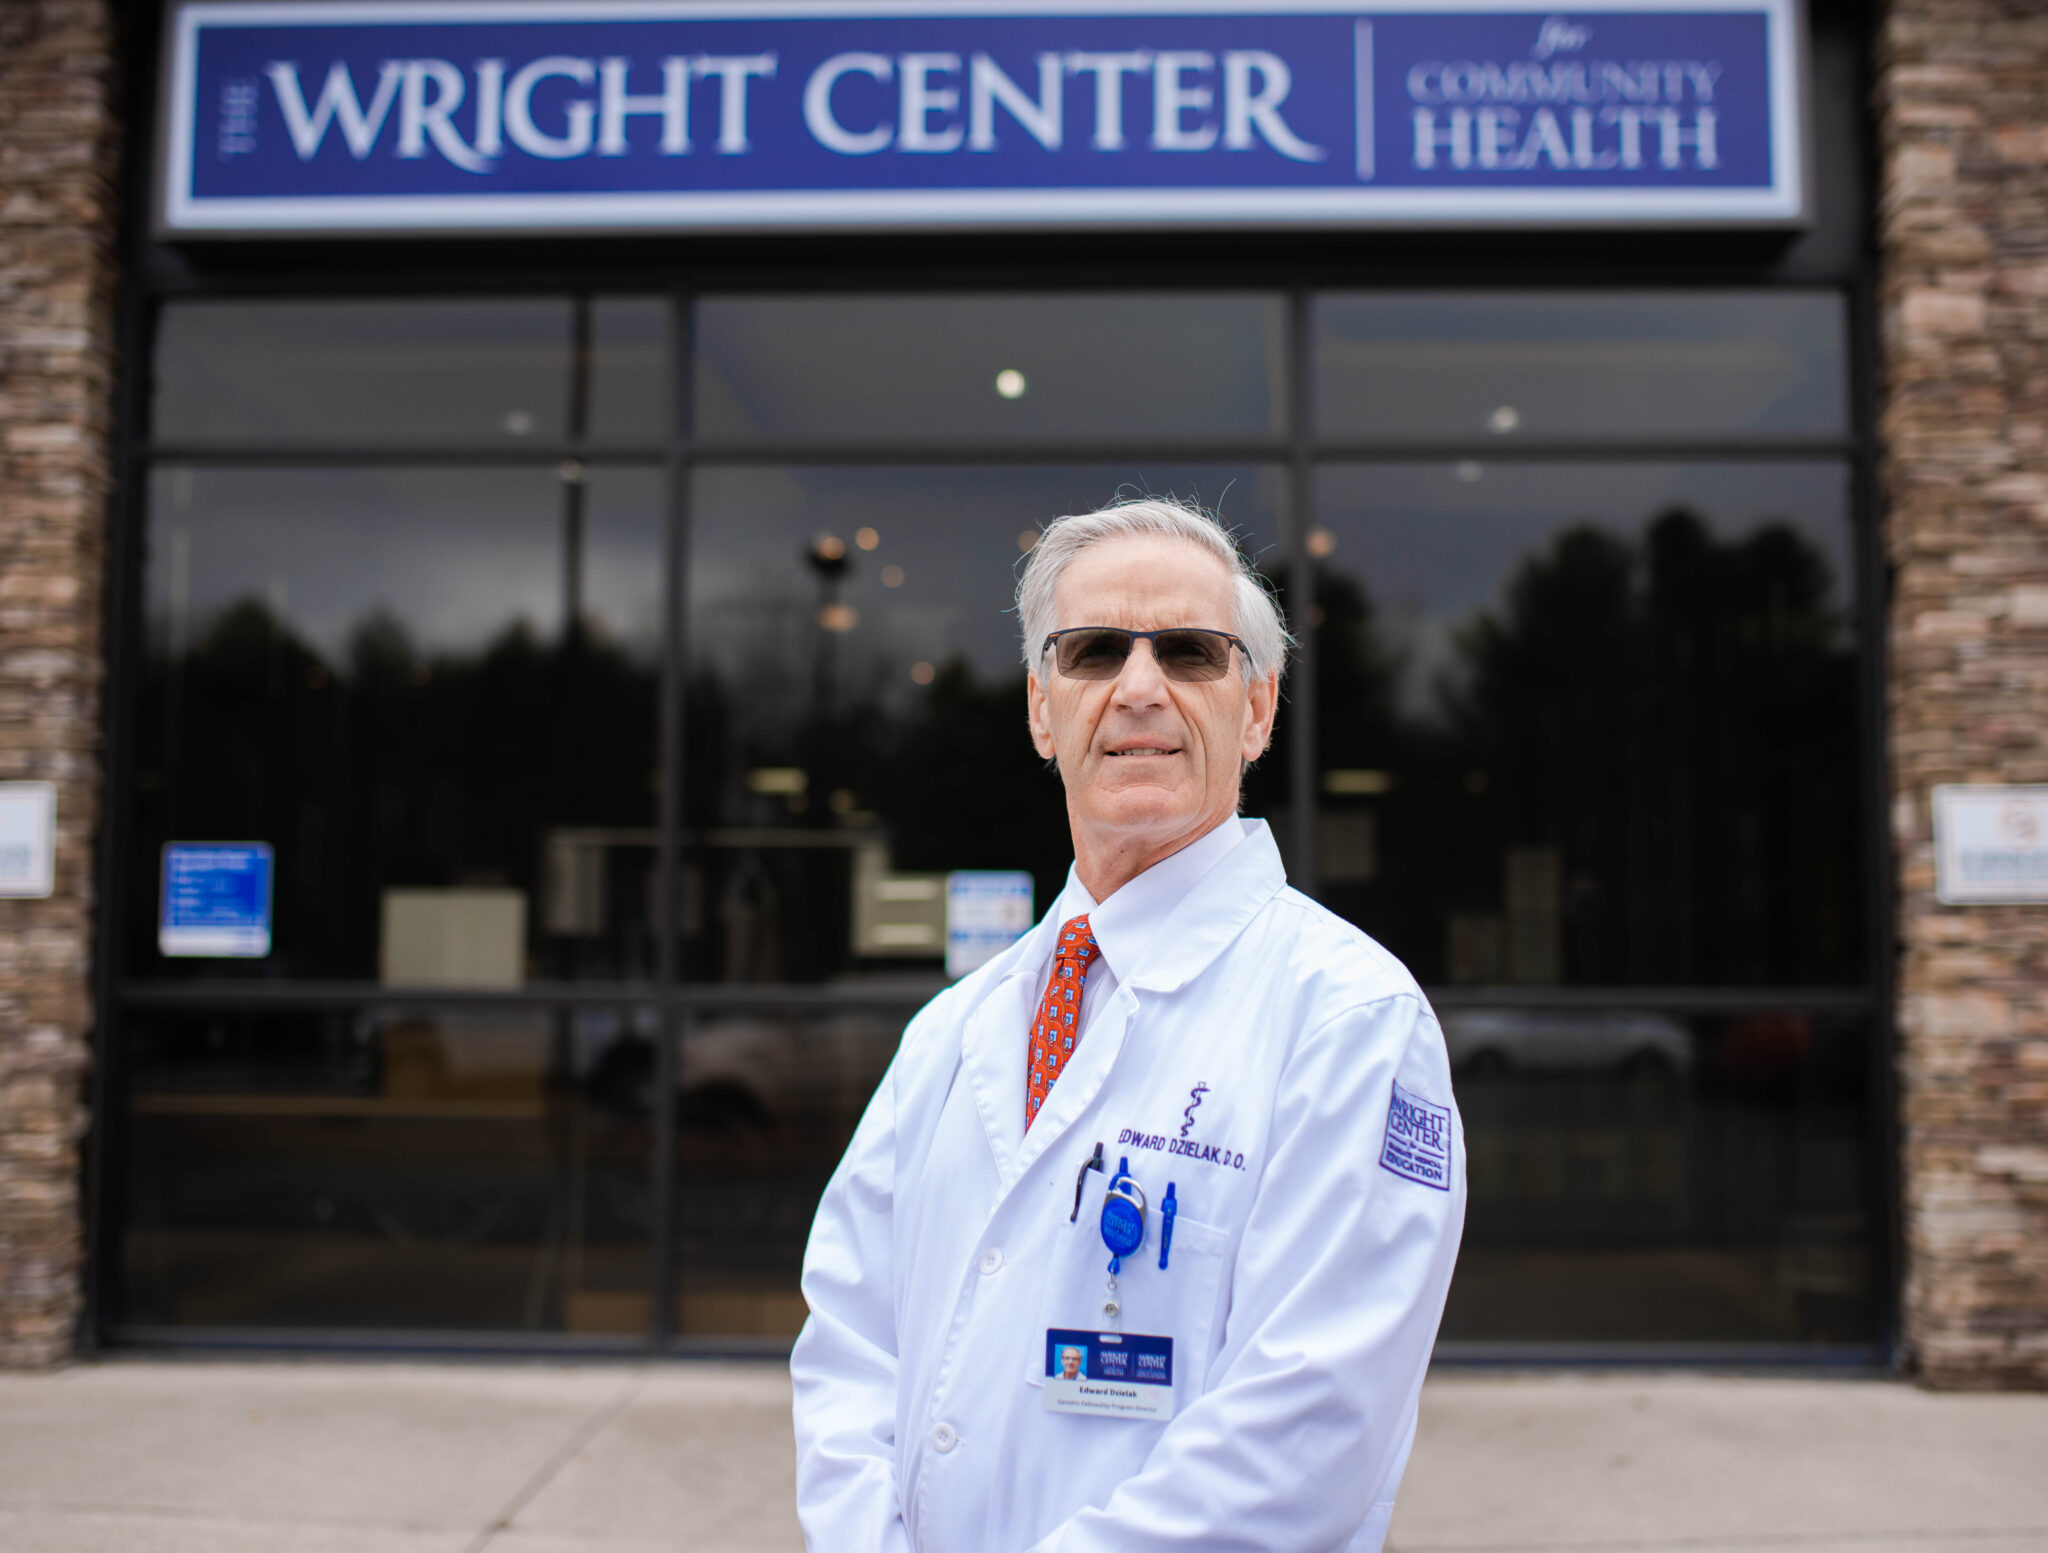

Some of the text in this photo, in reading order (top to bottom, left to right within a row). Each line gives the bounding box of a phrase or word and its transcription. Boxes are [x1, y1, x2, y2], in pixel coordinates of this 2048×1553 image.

[1407, 59, 1720, 104] COMMUNITY
[267, 49, 1327, 173] WRIGHT CENTER
[1412, 107, 1718, 170] HEALTH
[1391, 1095, 1446, 1133] WRIGHT
[1391, 1112, 1445, 1152] CENTER
[1118, 1129, 1166, 1151] EDWARD
[1223, 1150, 1246, 1171] D.O.
[1386, 1150, 1443, 1180] EDUCATION
[1079, 1386, 1137, 1398] Edward Dzielak
